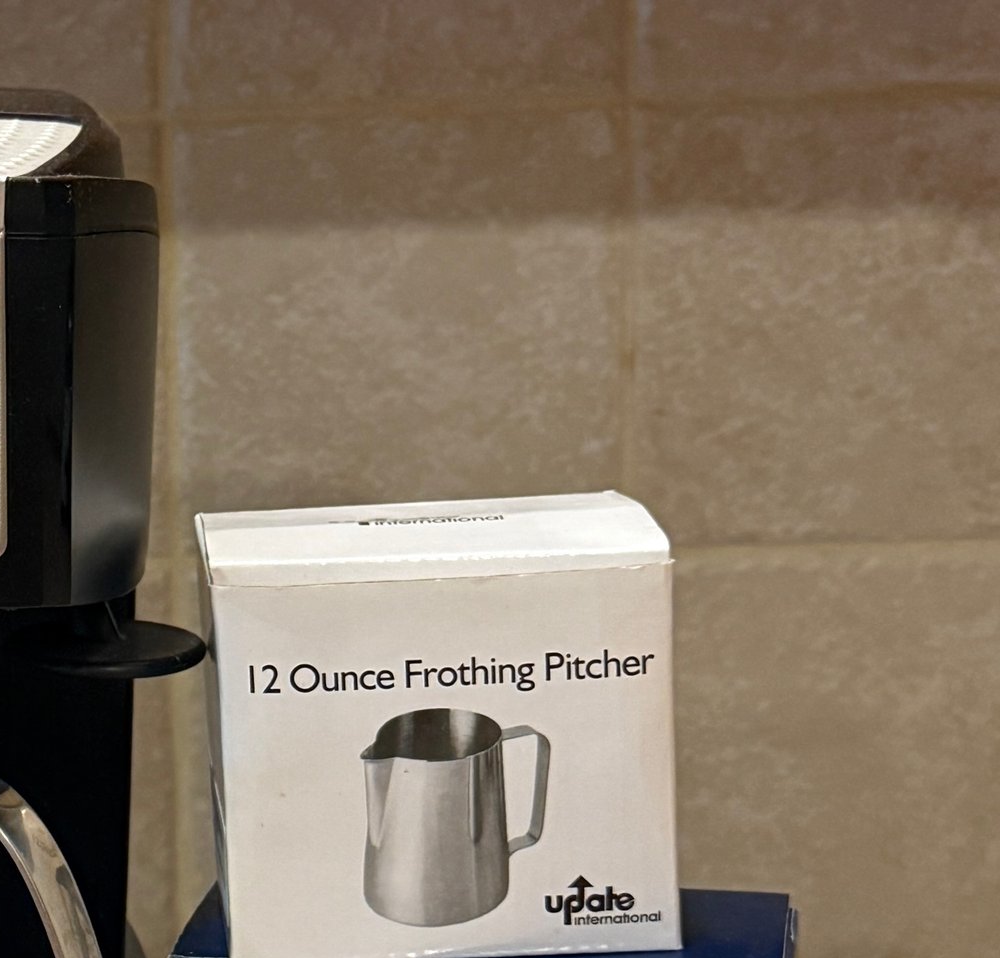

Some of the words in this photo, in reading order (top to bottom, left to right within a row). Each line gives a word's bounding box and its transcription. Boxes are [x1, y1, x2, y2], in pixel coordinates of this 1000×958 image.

[248, 664, 282, 694] 12
[289, 663, 396, 694] Ounce
[405, 656, 536, 692] Frothing
[545, 648, 655, 682] Pitcher
[574, 910, 662, 926] international
